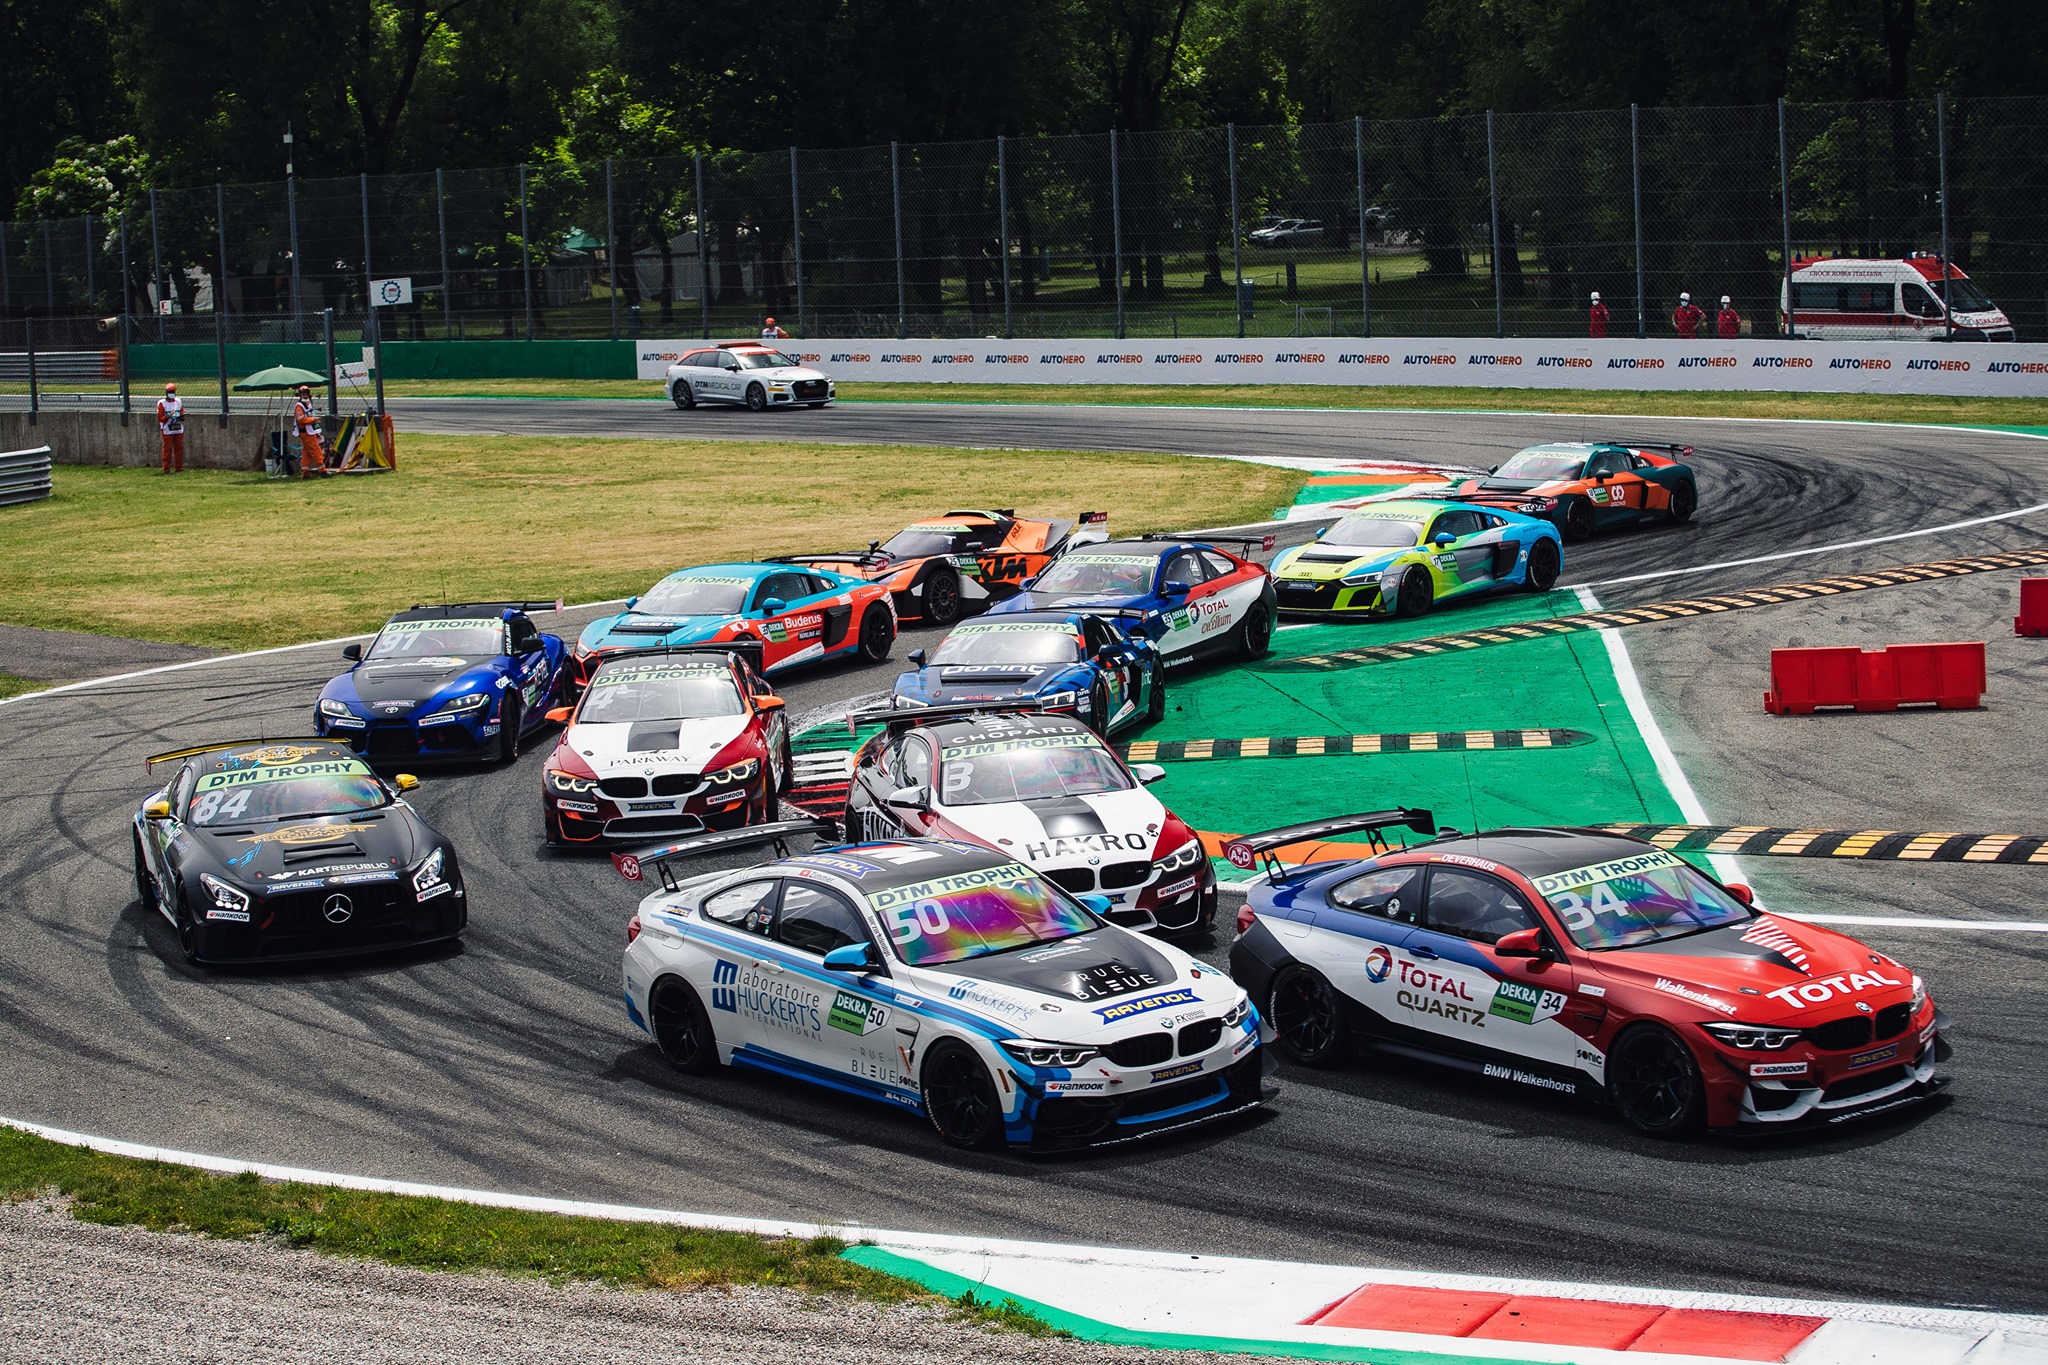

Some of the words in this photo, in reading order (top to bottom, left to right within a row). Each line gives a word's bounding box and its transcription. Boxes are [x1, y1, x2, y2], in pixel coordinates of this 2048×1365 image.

[642, 353, 678, 361] AUTOHERO
[786, 353, 820, 362] UTOHERO
[830, 353, 870, 362] AUTOHERO
[880, 354, 922, 363] AUTOHERO
[932, 354, 974, 363] AUTOHERO
[985, 354, 1029, 364] AUTOHERO
[1040, 355, 1085, 364] AUTOHERO
[1096, 354, 1143, 364] AUTOHERO
[1154, 354, 1202, 364] AUTOHERO
[1214, 354, 1263, 364] AUTOHERO
[1275, 353, 1325, 363] AUTOHERO
[1338, 354, 1389, 364] AUTOHERO
[1403, 354, 1456, 365] AUTOHERO
[1468, 355, 1522, 366] AUTOHERO
[1536, 356, 1593, 368] AUTOHERO
[1607, 358, 1665, 369] AUTOHERO
[1678, 357, 1737, 368] AUTOHERO
[1752, 357, 1813, 368] AUTOHERO
[1829, 358, 1891, 370] AUTOHERO
[1906, 359, 1971, 371] AUTOHERO
[1372, 513, 1423, 521] TROPHY
[1093, 556, 1154, 565] TROPHY
[1440, 553, 1455, 562] DEKRA
[1200, 599, 1229, 615] TOTAL
[389, 623, 423, 631] DTM
[428, 621, 498, 629] TROPHY
[768, 622, 785, 631] DEKRA
[784, 614, 822, 629] Buderus
[955, 624, 994, 635] DTM
[999, 624, 1071, 632] TROPHY
[376, 632, 422, 654] 91
[608, 661, 717, 675] CHOPARD
[597, 673, 638, 686] DTM
[643, 669, 727, 681] TROPHY
[951, 726, 1077, 743] CHOPARD
[946, 744, 995, 759] DTM
[1003, 735, 1090, 751] TROPHY
[610, 754, 693, 767] PARKWAY
[209, 771, 258, 787] DTM
[266, 763, 353, 778] TROPHY
[715, 790, 744, 803] HANKOOK
[193, 789, 253, 824] 84
[566, 802, 596, 811] HANKOOK
[631, 802, 673, 810] RAVENOL
[1026, 833, 1147, 861] HAKRO
[1441, 853, 1498, 872] OEVERHAUS
[348, 873, 391, 881] RAVENOL
[810, 871, 835, 883] Zimmer
[1538, 870, 1593, 893] DTM
[1595, 853, 1674, 878] TROPHY
[272, 880, 318, 891] RAVENOL
[876, 886, 932, 907] DTM
[938, 863, 1031, 892] TROPHY
[1165, 880, 1194, 893] HANKOOK
[1549, 884, 1629, 931] 34
[214, 911, 249, 921] HANKOOK
[886, 899, 951, 946] 50
[1079, 964, 1125, 982] RUE
[738, 966, 820, 1008] laboratoire
[1398, 959, 1474, 1002] TOTAL
[1072, 974, 1159, 1001] BLEUE
[1500, 981, 1537, 1004] DEKRA
[1766, 970, 1902, 1008] TOTAL
[1541, 992, 1561, 1012] 34
[1654, 977, 1737, 1015] Walkenhorst
[737, 984, 821, 1032] HUCKERT'S
[836, 992, 868, 1016] DEKRA
[1103, 990, 1192, 1019] RAVENOL
[1396, 990, 1485, 1027] QUARTZ
[868, 1006, 885, 1027] 50
[1507, 1005, 1531, 1018] TROPHY
[738, 1009, 823, 1042] INTERNATIONAL
[842, 1017, 862, 1029] TROPHY
[860, 1047, 884, 1062] RUE
[852, 1059, 896, 1084] BLEUE
[1155, 1062, 1201, 1081] RAVENOL
[1763, 1064, 1806, 1074] HANKOOK
[1483, 1063, 1512, 1081] BMW
[1513, 1068, 1576, 1094] Walkenhorst
[1058, 1082, 1104, 1091] HANKOOK
